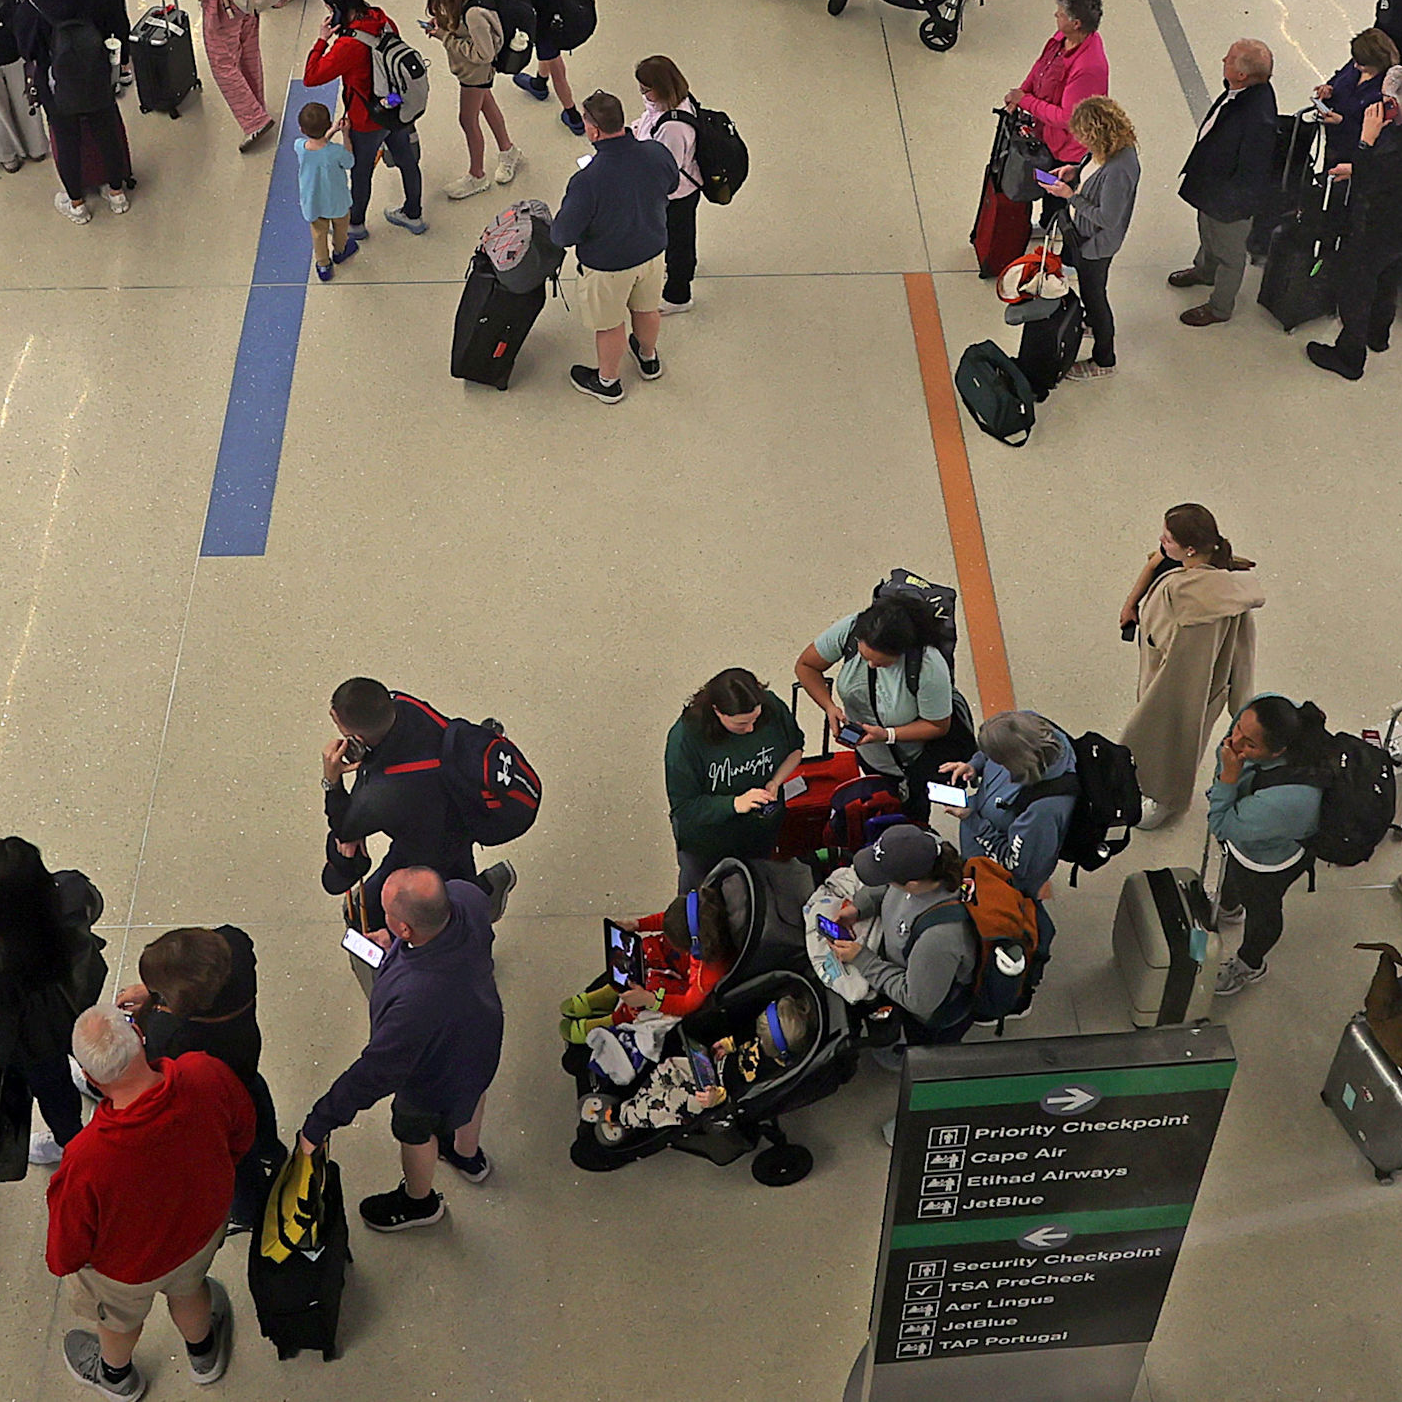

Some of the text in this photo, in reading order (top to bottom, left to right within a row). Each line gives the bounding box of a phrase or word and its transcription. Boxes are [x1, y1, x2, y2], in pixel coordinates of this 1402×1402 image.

[708, 747, 775, 793] Minnesota
[974, 1114, 1191, 1141] Priority Checkpoint
[970, 1146, 1067, 1167] Cape Air
[966, 1165, 1129, 1188] Etihad Airways
[962, 1194, 1044, 1211] JetBlue
[952, 1246, 1162, 1273] Security Checkpoint
[947, 1271, 1096, 1293] TSA PreCheck
[944, 1294, 1055, 1313] Aer Lingus
[942, 1316, 1018, 1333] JetBlue
[939, 1331, 1069, 1351] TAP Portugal
